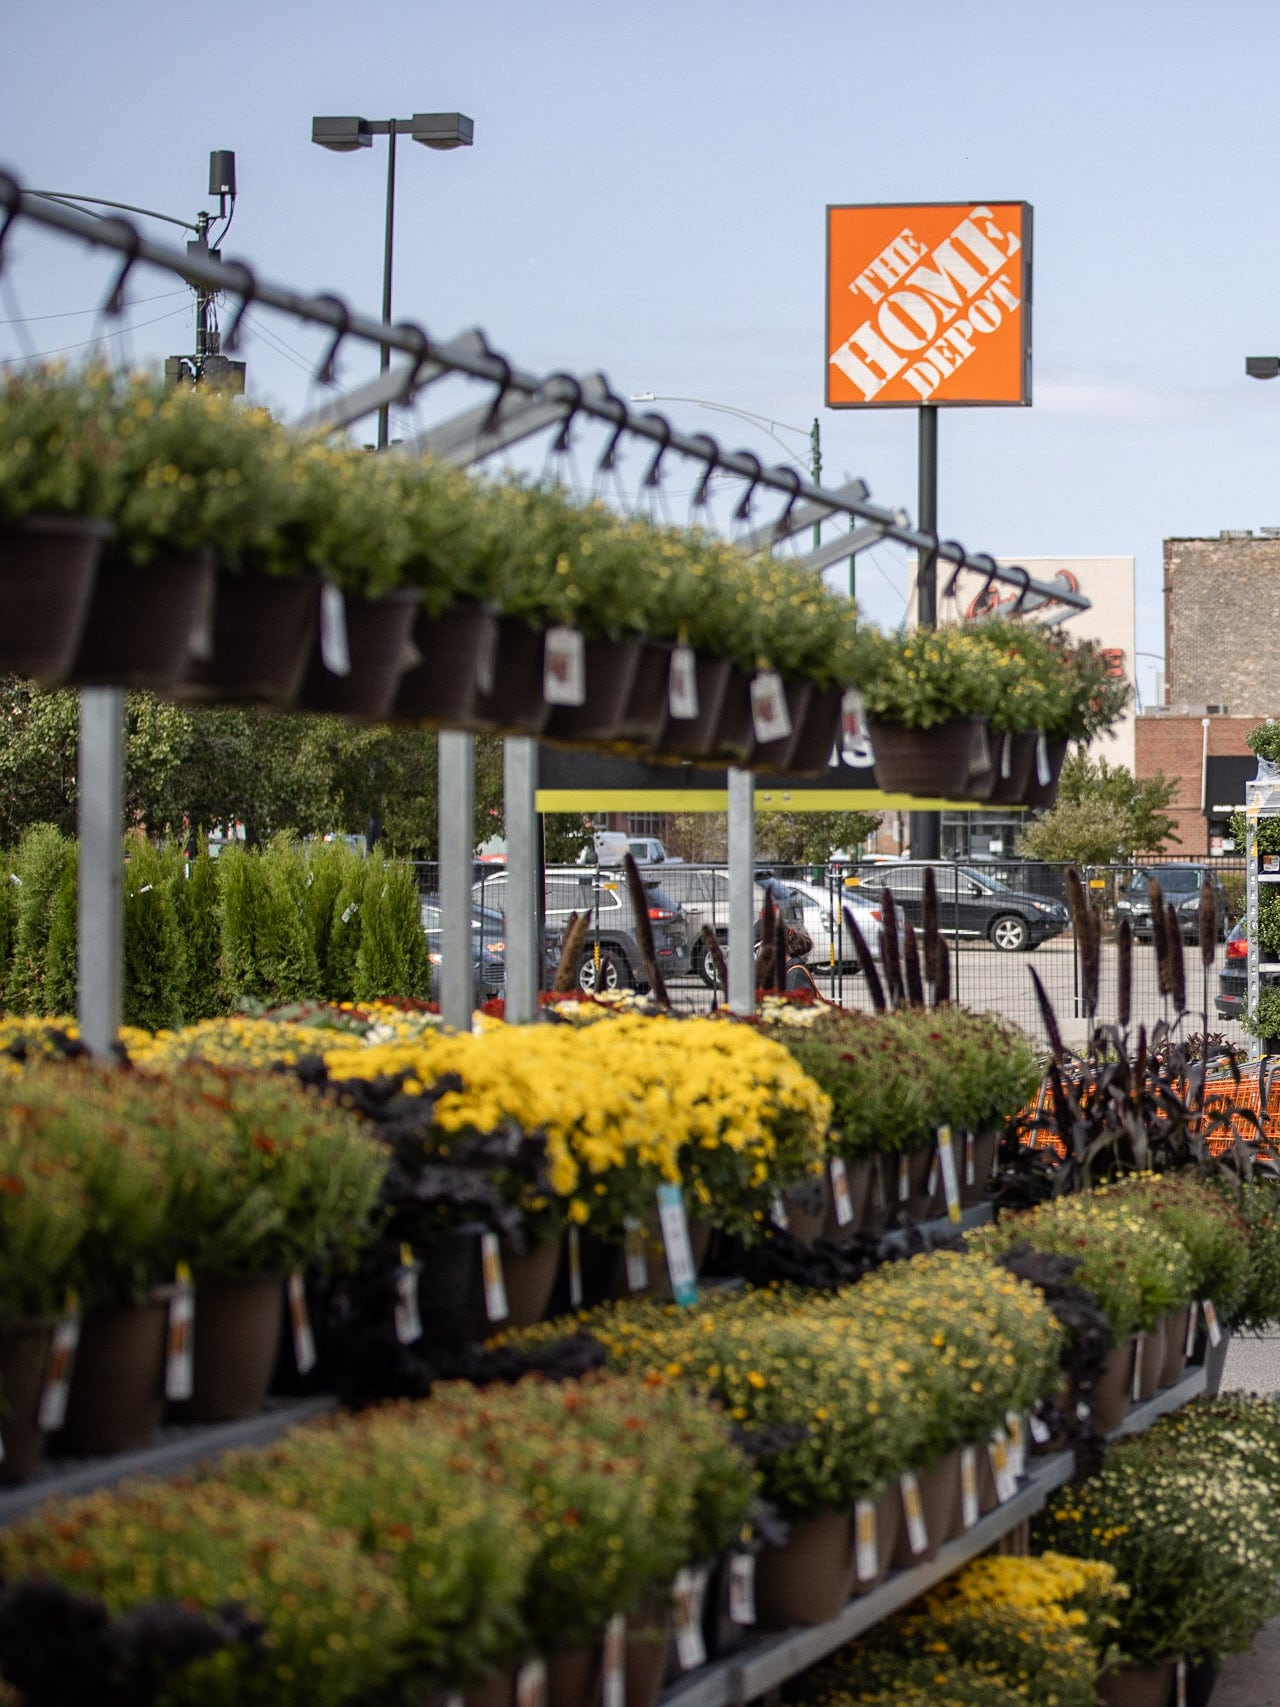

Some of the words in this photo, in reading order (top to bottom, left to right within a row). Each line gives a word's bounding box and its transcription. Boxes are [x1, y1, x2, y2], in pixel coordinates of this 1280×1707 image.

[829, 205, 1021, 402] HOME
[848, 227, 928, 304] THE
[902, 274, 1021, 401] DEPOT
